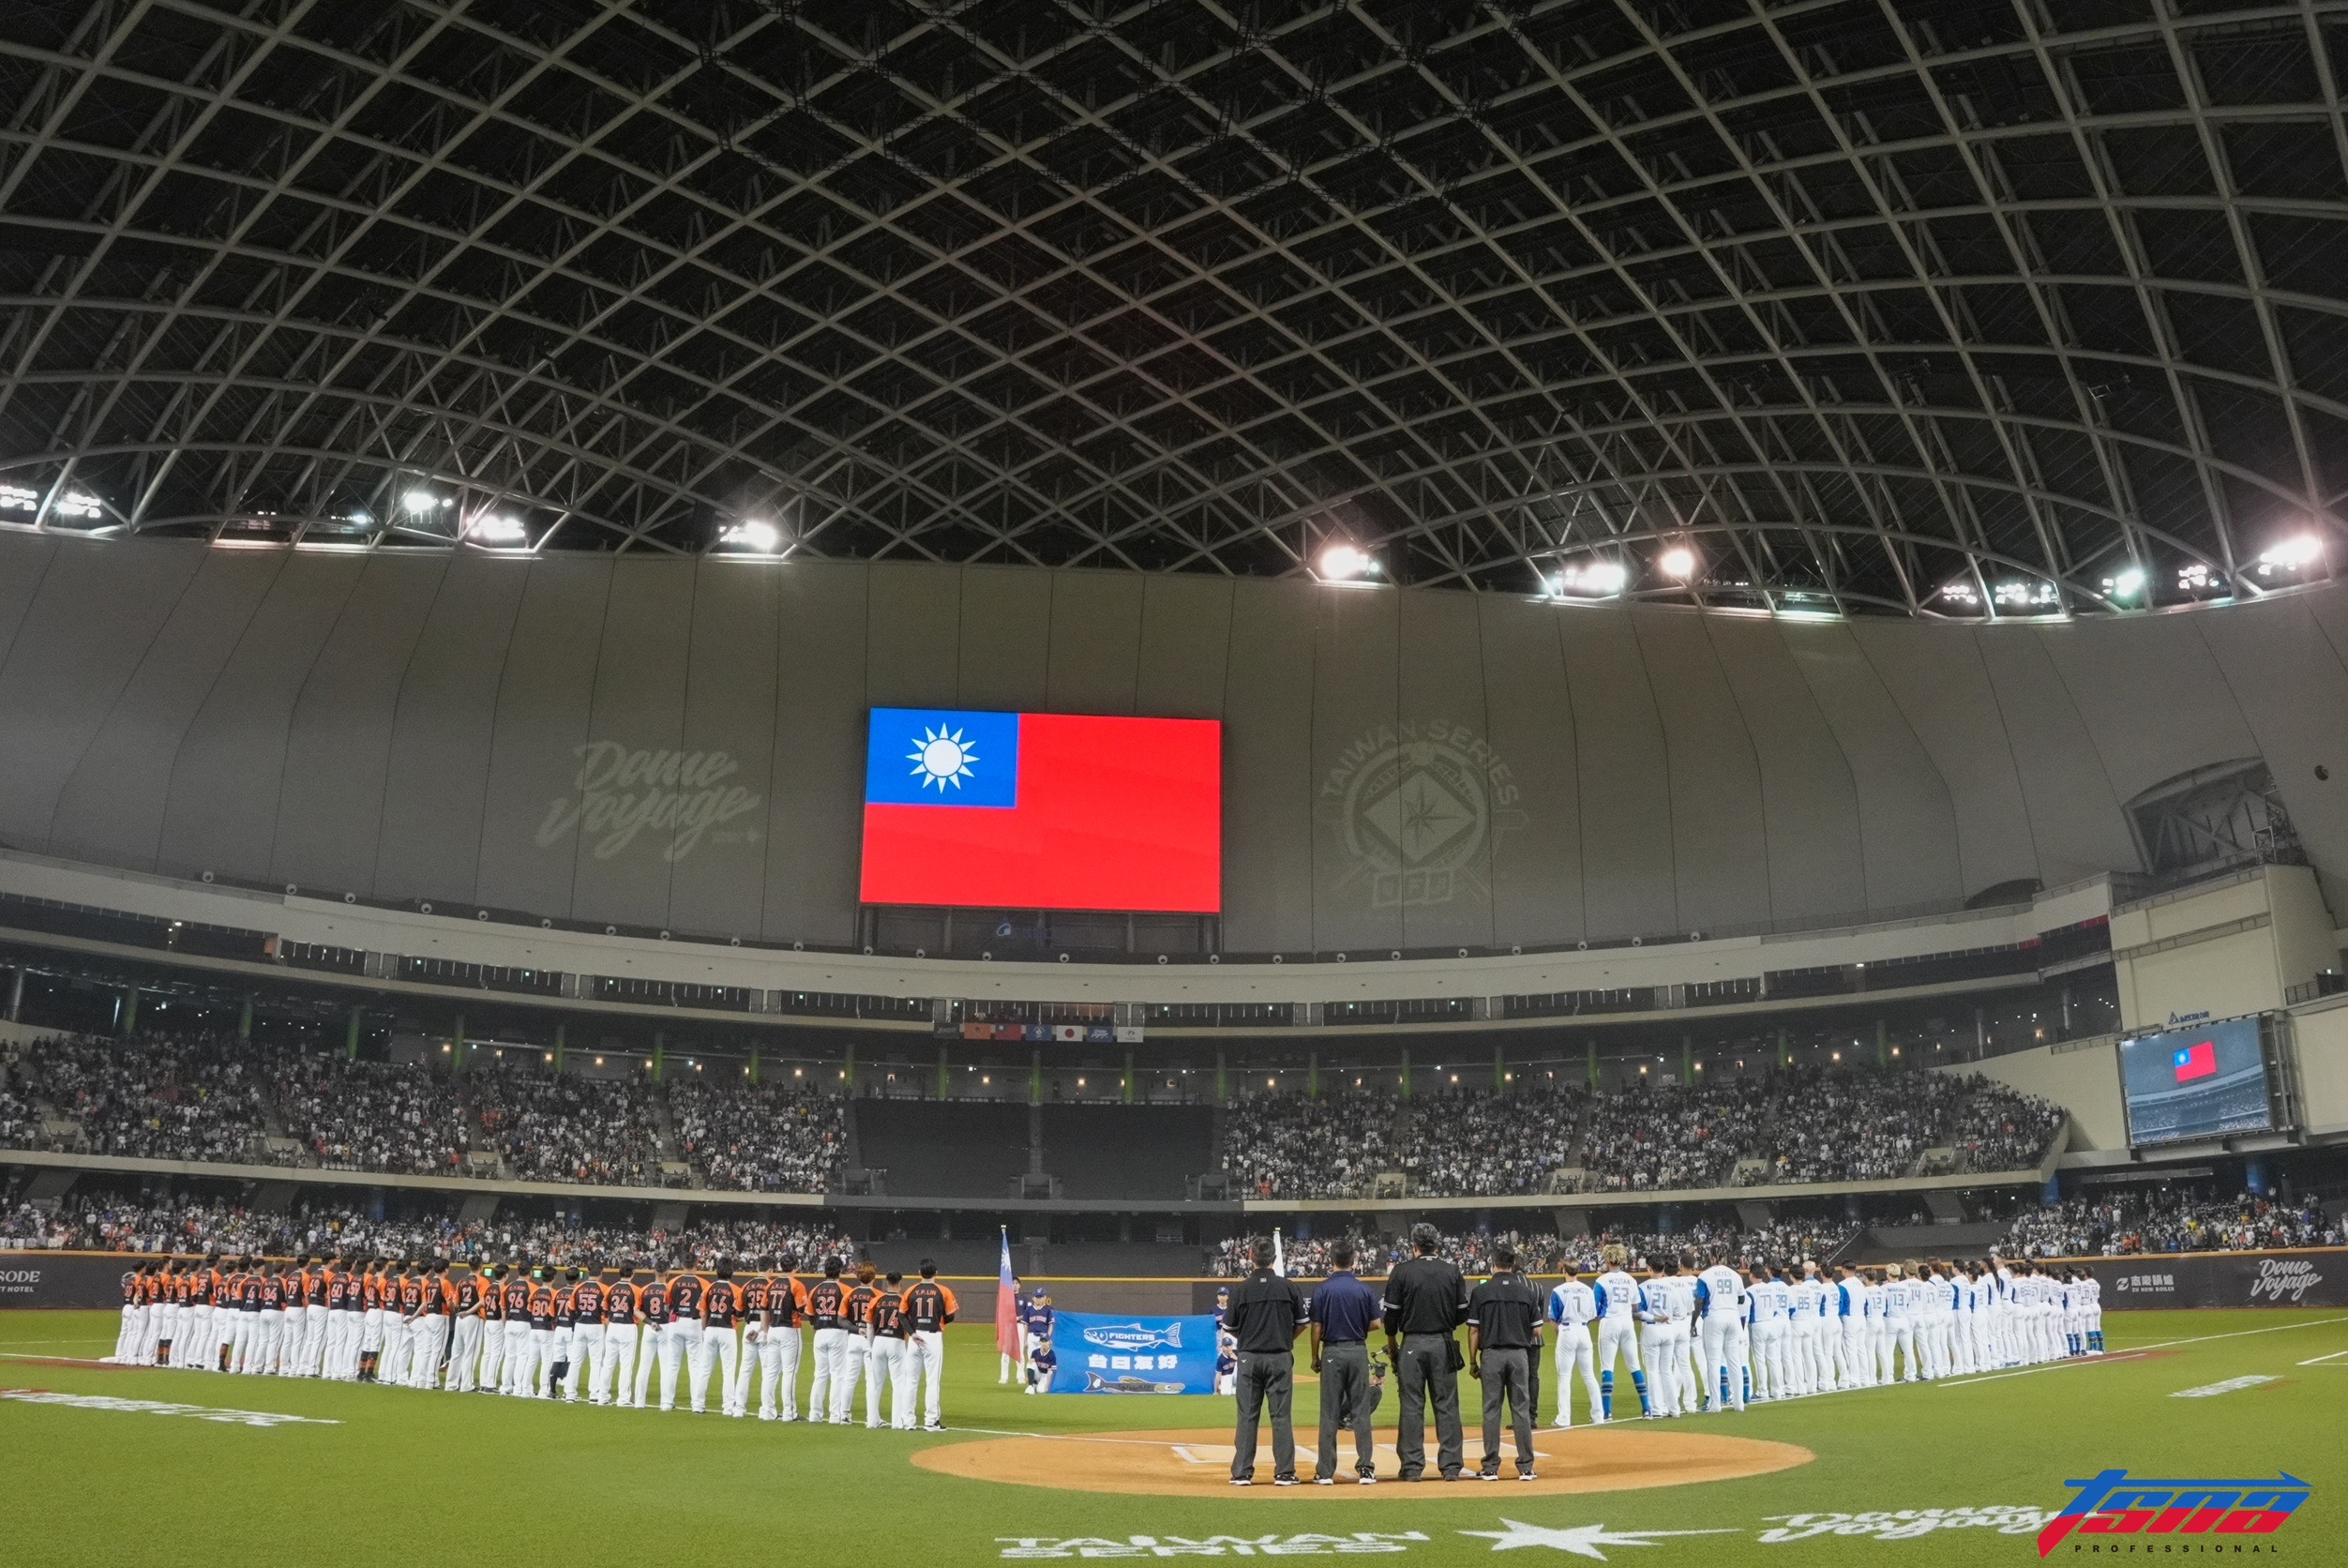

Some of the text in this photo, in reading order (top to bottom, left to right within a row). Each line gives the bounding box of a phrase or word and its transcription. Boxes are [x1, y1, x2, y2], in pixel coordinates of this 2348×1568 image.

[574, 740, 739, 791] Dome
[1427, 718, 1519, 805] SERIES
[534, 784, 760, 862] Voyage
[2259, 1259, 2313, 1277] Dome
[1717, 1278, 1732, 1294] 99
[2250, 1274, 2323, 1302] Voyage
[427, 1289, 438, 1304] 17
[507, 1292, 524, 1310] 96
[578, 1294, 597, 1311] 55
[610, 1295, 629, 1313] 34
[679, 1289, 692, 1306] 2
[709, 1294, 728, 1313] 66
[770, 1290, 787, 1309] 77
[1573, 1296, 1580, 1312] 7
[1613, 1287, 1629, 1304] 53
[1651, 1292, 1667, 1310] 21
[1759, 1294, 1772, 1308] 77
[1798, 1296, 1810, 1310] 85
[1893, 1294, 1904, 1306] 13
[1911, 1289, 1921, 1302] 14
[532, 1300, 549, 1317] 80
[650, 1297, 661, 1315] 8
[816, 1296, 836, 1316] 32
[915, 1297, 934, 1318] 11
[879, 1308, 899, 1329] 14
[1109, 1333, 1155, 1341] FIGHTERS
[1089, 1354, 1178, 1370] 台日友好
